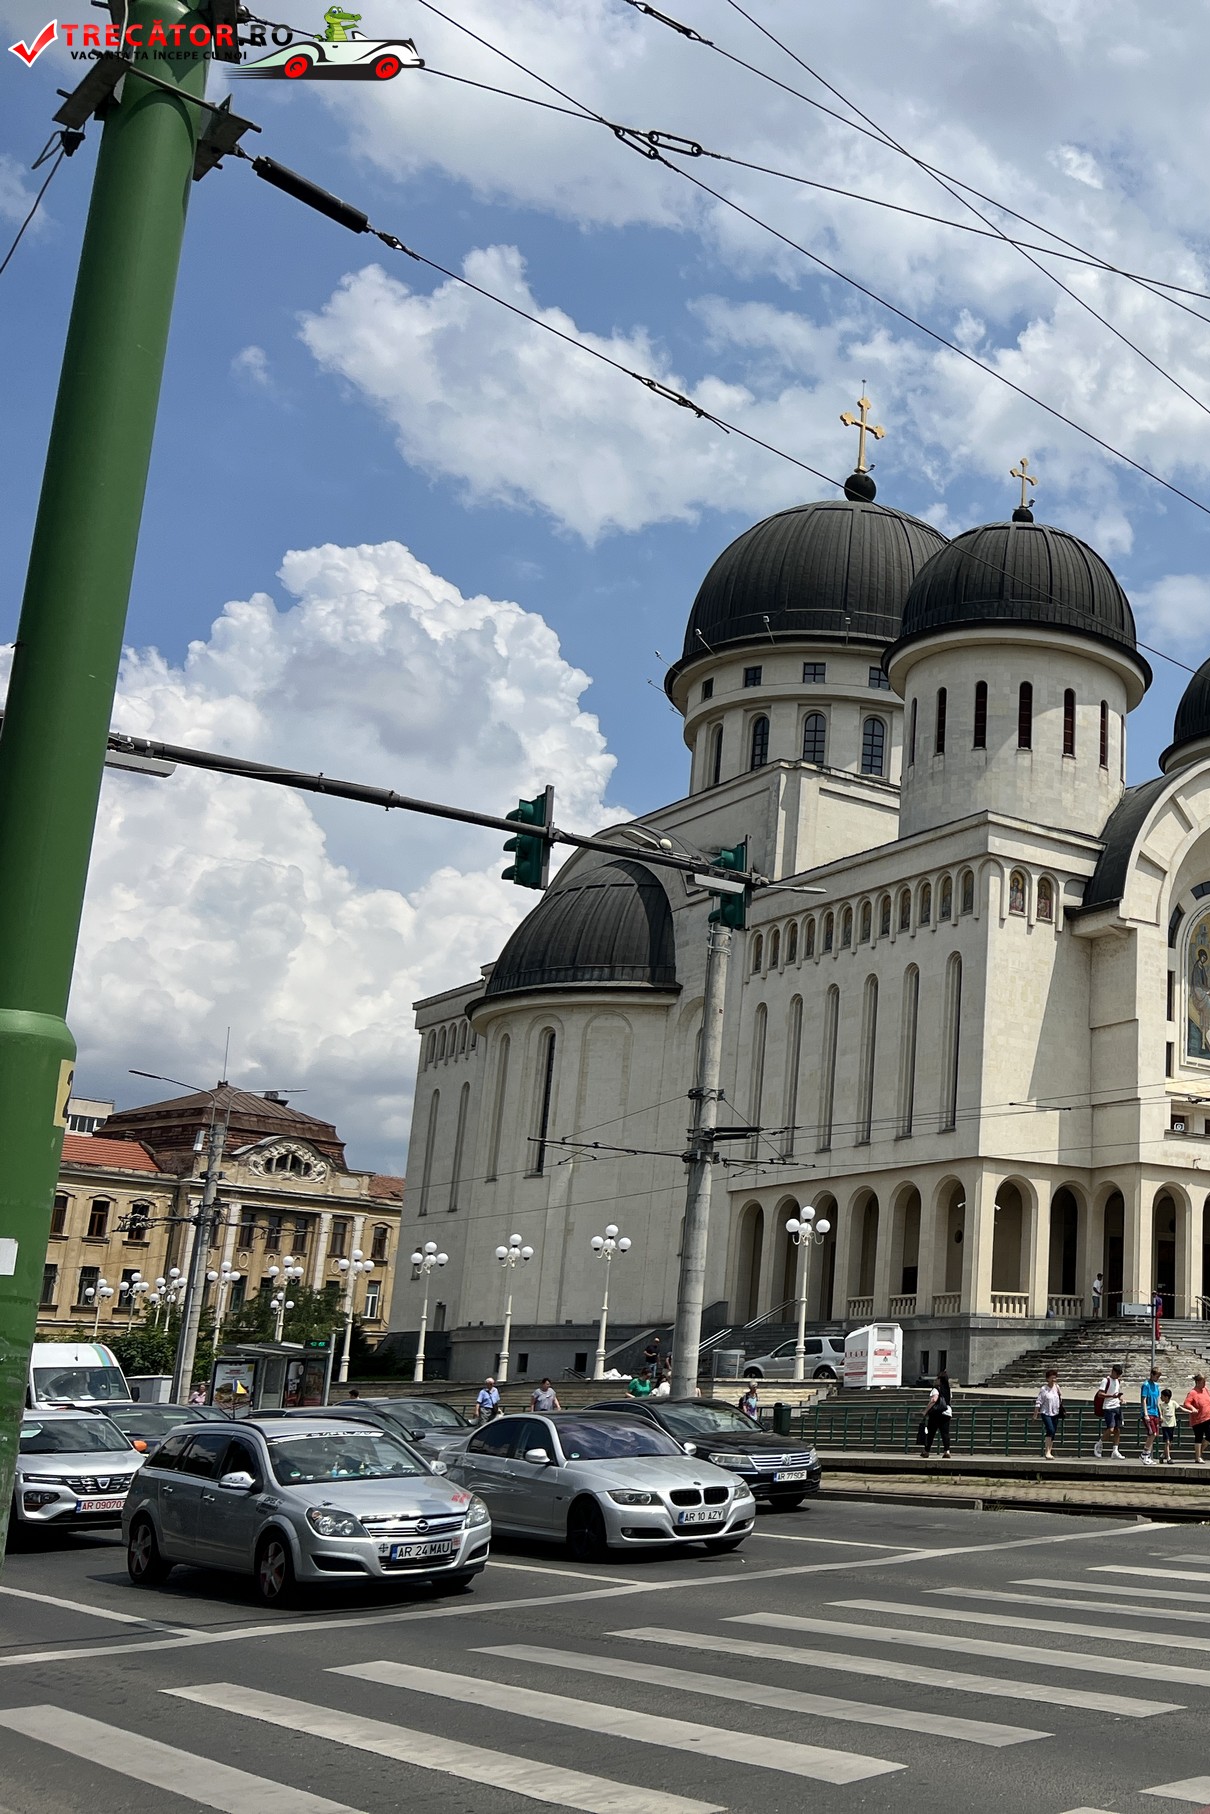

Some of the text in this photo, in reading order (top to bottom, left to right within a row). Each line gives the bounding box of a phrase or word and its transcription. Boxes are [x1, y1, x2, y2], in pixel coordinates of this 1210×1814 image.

[398, 1542, 450, 1557] AR 24 MAU
